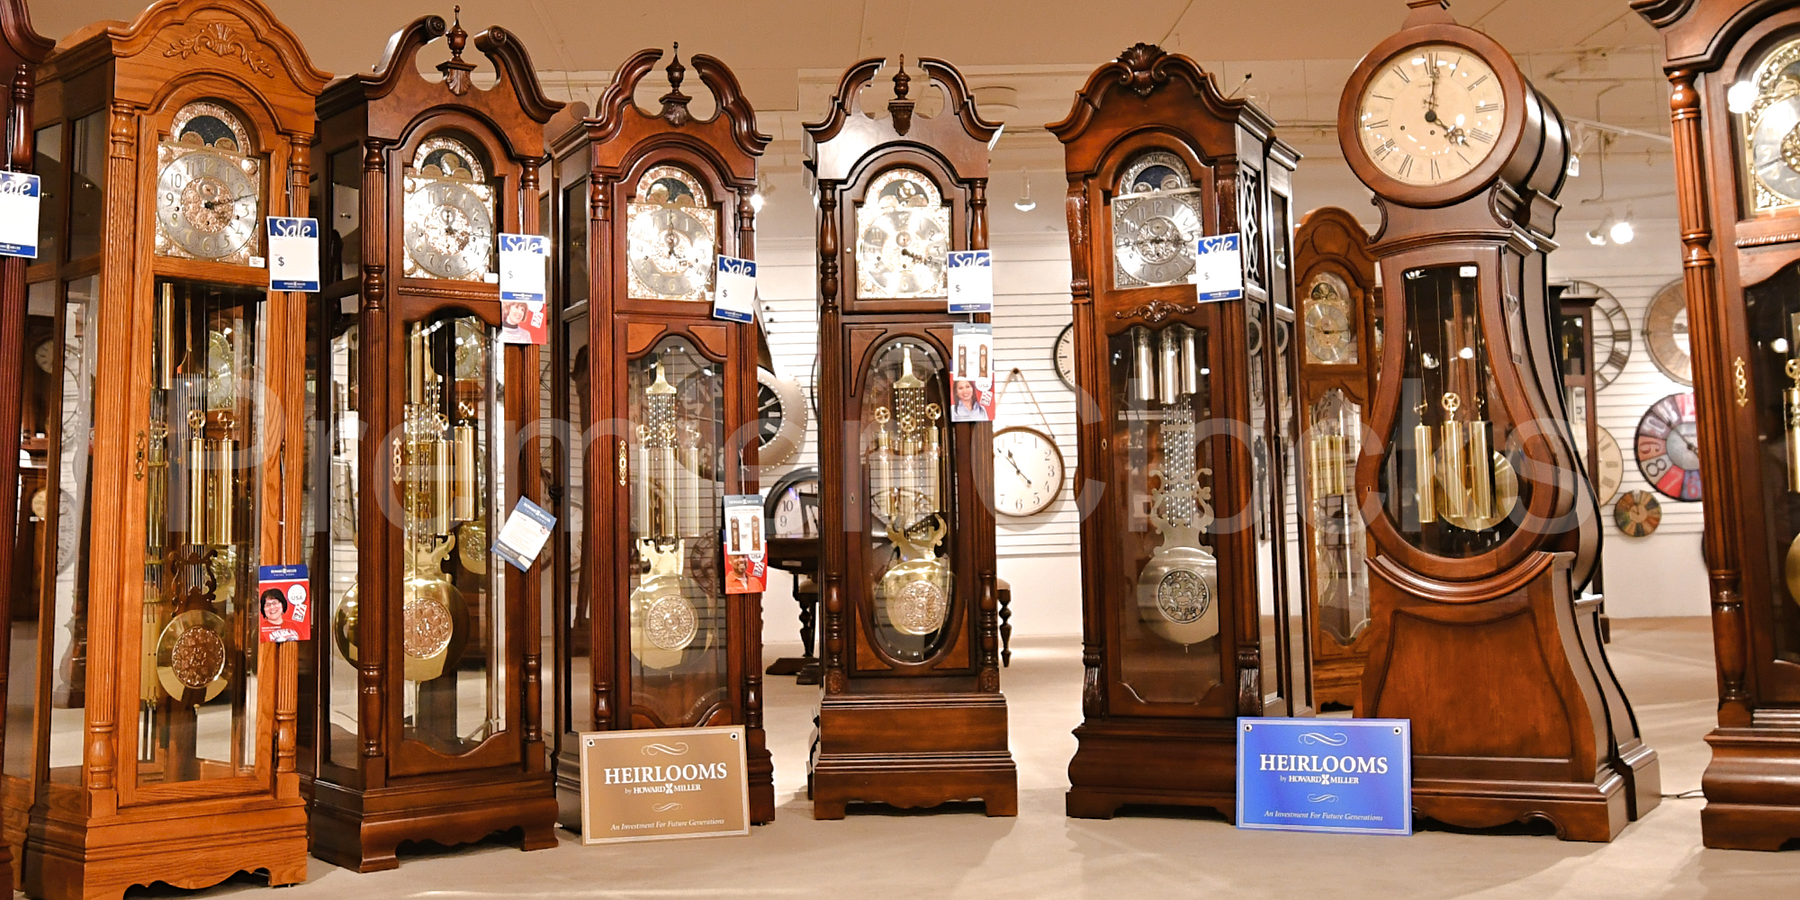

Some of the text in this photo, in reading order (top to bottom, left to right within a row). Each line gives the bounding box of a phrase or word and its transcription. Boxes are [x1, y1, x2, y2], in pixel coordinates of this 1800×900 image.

[0, 174, 32, 195] ale
[171, 173, 182, 188] 10
[166, 192, 174, 206] 9
[242, 203, 249, 218] 3
[275, 219, 312, 238] Sale
[1126, 220, 1135, 233] 10
[203, 237, 211, 252] 6
[222, 235, 230, 248] 5
[506, 235, 540, 253] Sale
[1202, 237, 1233, 254] Sale
[933, 245, 940, 256] 3
[278, 256, 285, 267] $
[445, 258, 451, 272] 6
[953, 252, 986, 268] Sale
[723, 258, 752, 276] Sale
[507, 270, 514, 279] $
[1204, 271, 1210, 280] $
[722, 289, 728, 298] $
[955, 284, 961, 293] $
[1045, 449, 1051, 461] 2
[1047, 465, 1055, 477] 3
[1646, 458, 1667, 477] 8
[1045, 480, 1050, 493] 4
[1687, 475, 1699, 499] 6
[1000, 493, 1005, 505] 7
[1015, 498, 1023, 510] 6
[1033, 492, 1040, 505] 5
[783, 500, 794, 512] 10
[780, 515, 787, 527] 9
[1259, 754, 1388, 774] HEIRLOOMS
[604, 762, 728, 785] HEIRLOOMS
[1280, 775, 1359, 784] by HOWARD MILLER
[624, 784, 702, 795] by HOWARD MILLER
[1275, 810, 1308, 819] Investment
[1322, 812, 1343, 820] Future
[1344, 812, 1383, 821] Generations
[611, 818, 725, 831] An Investment For Future Generations
